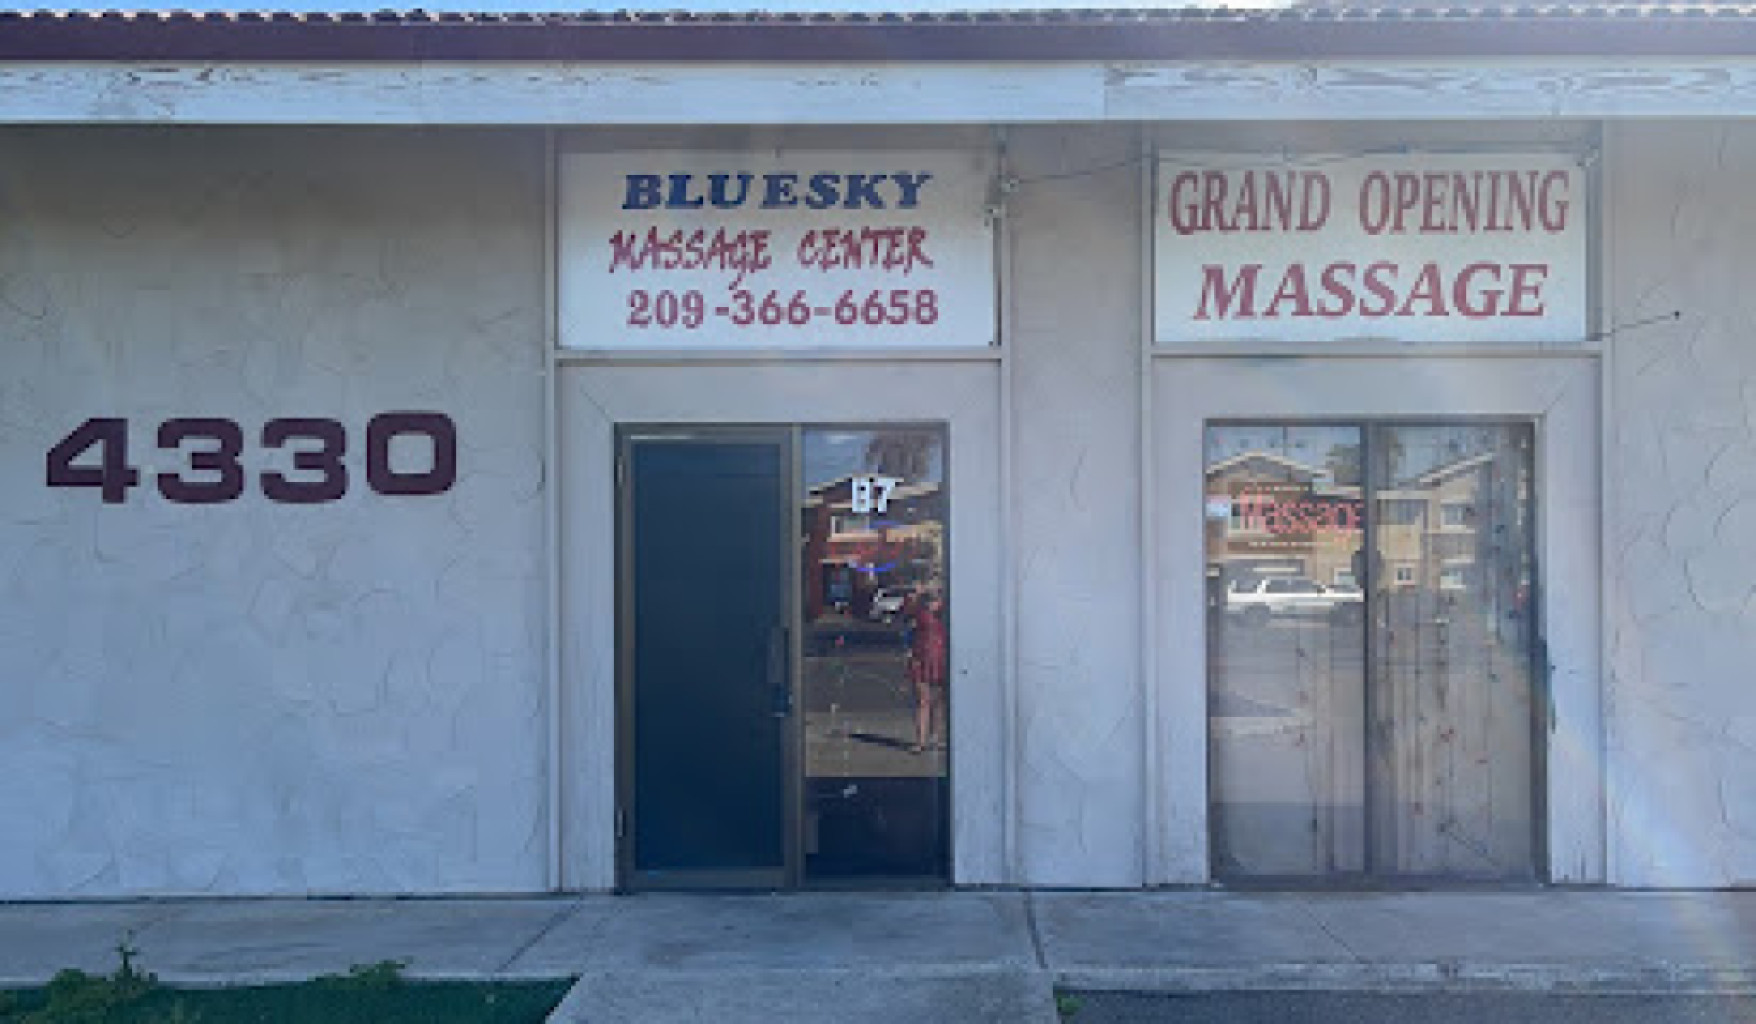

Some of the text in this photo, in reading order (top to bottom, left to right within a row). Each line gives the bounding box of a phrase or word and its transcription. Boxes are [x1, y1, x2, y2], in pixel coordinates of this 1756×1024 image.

[622, 173, 934, 210] BLUESKY
[1169, 169, 1570, 235] GRAND OPENING
[609, 226, 934, 289] MASSAGE CENTER
[627, 289, 939, 328] 209-366-6658
[1194, 261, 1549, 320] MASSAGE
[46, 411, 457, 503] 4330
